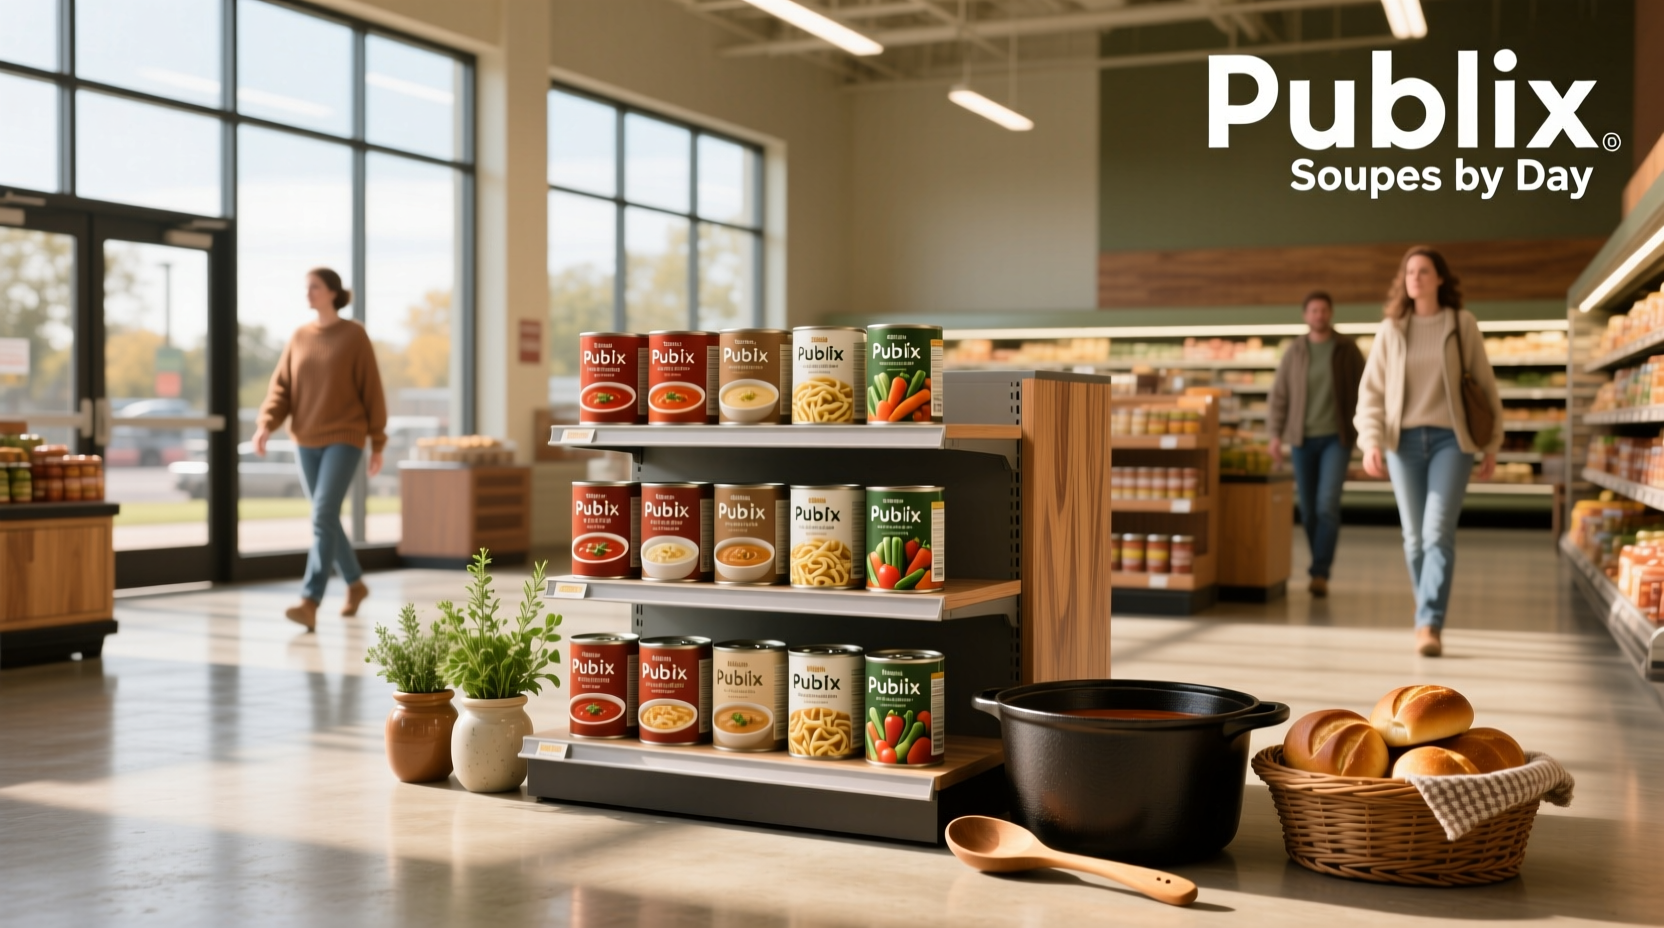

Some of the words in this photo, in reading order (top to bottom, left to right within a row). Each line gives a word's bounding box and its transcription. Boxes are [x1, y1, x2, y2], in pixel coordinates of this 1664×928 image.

[872, 342, 921, 359] Publix
[871, 505, 921, 523] Publix
[868, 676, 921, 695] Publix
